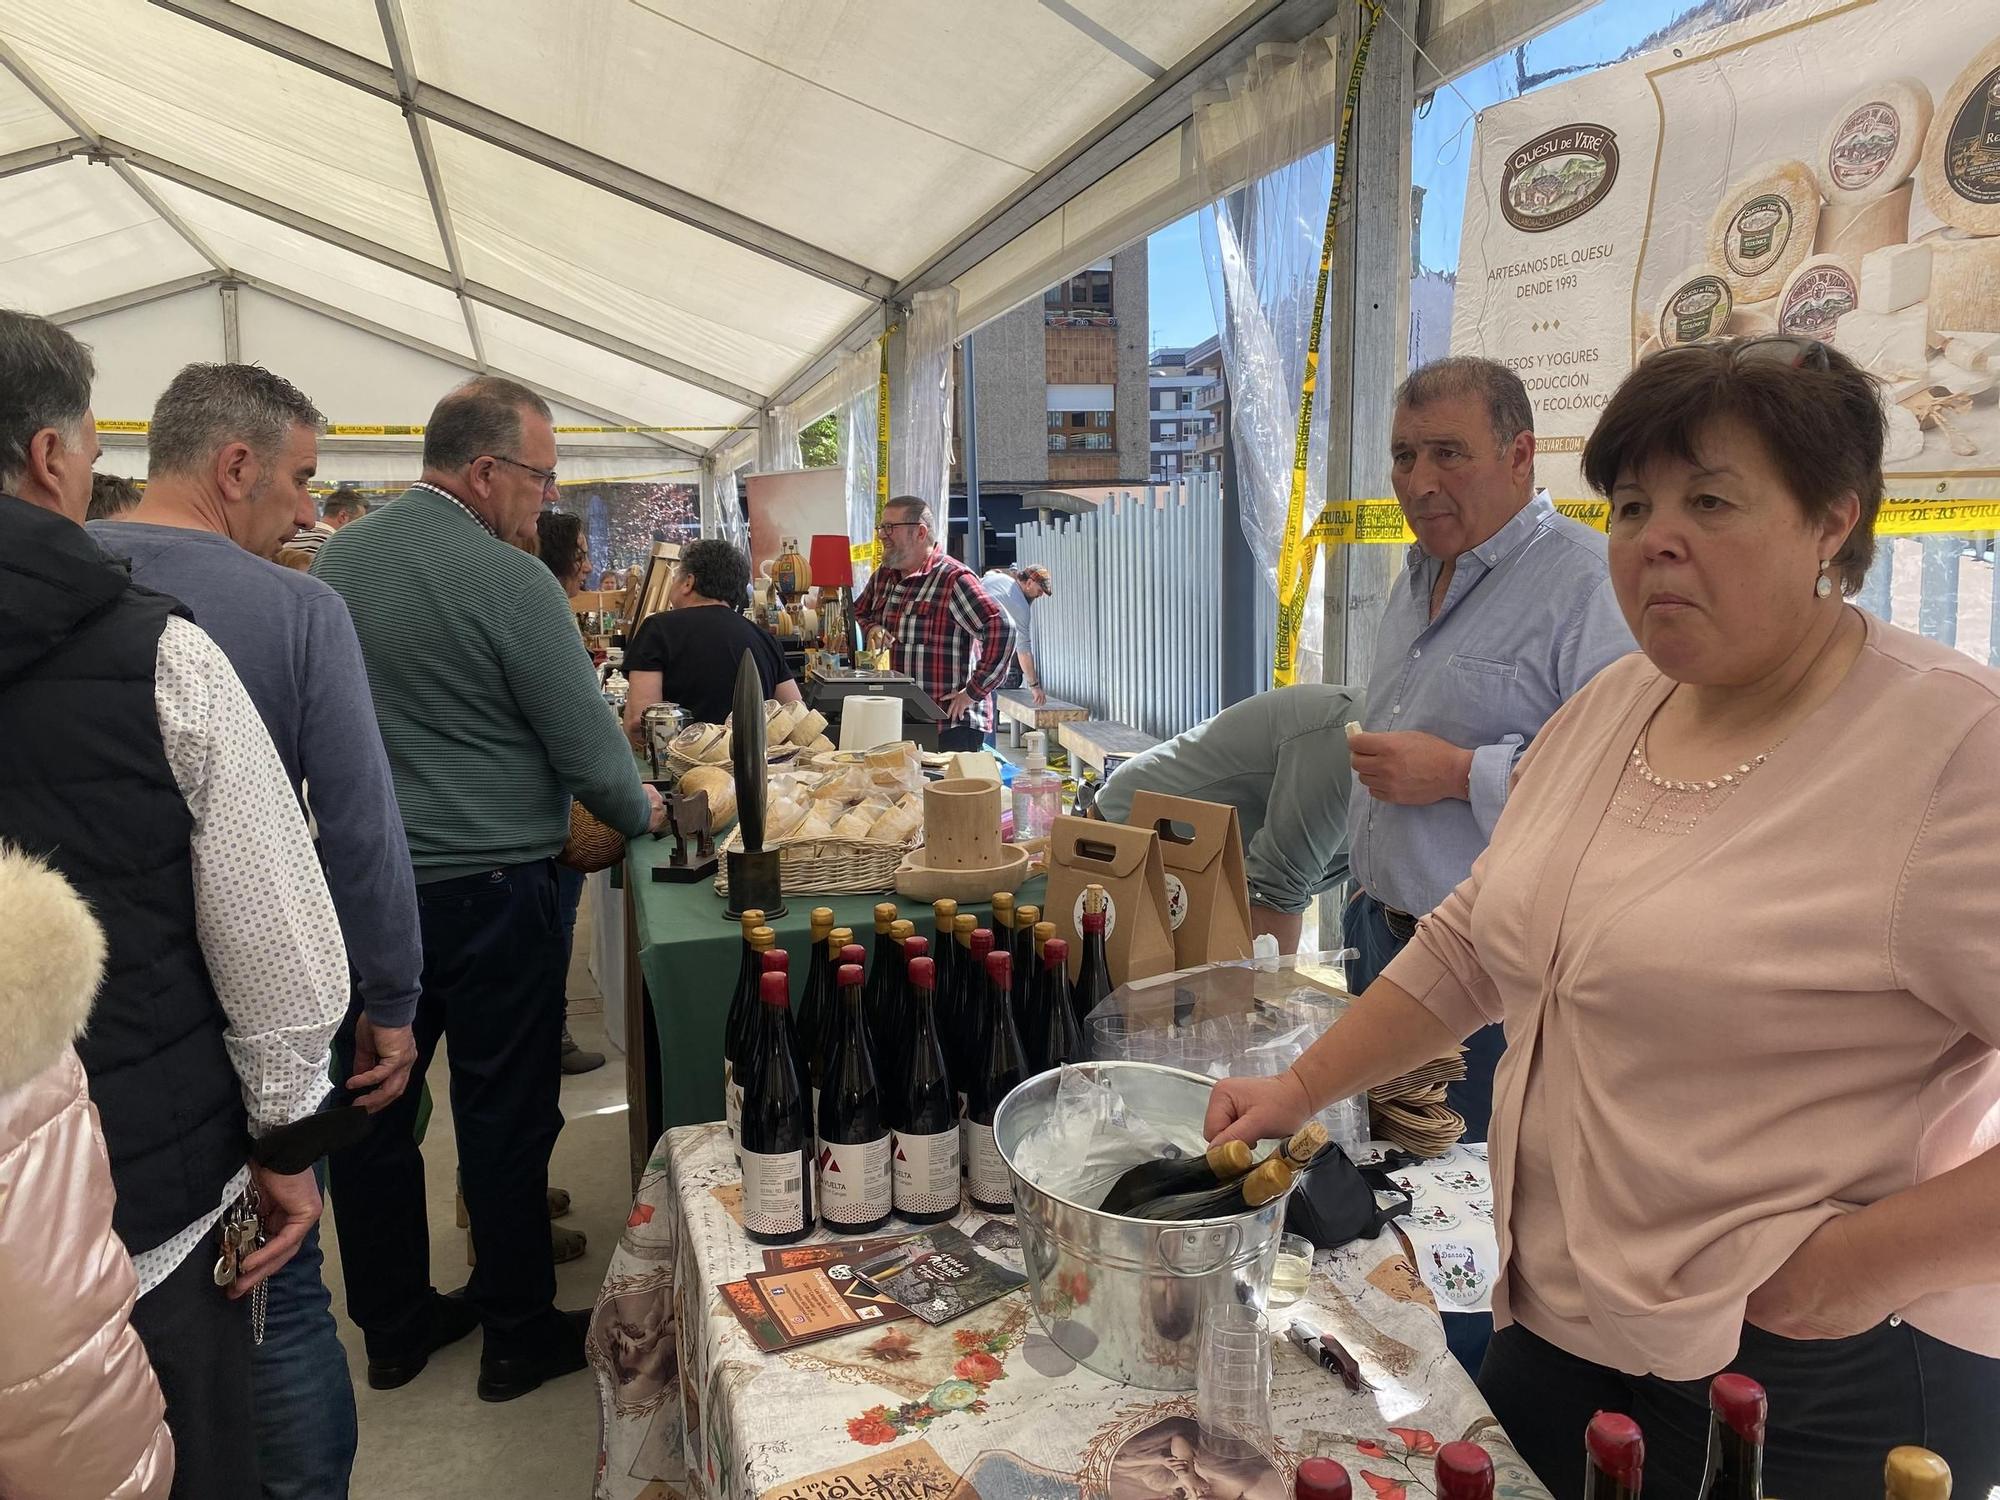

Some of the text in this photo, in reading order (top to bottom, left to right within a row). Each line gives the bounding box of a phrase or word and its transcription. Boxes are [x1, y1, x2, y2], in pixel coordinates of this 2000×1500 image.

[1514, 139, 1558, 169] QUESU
[1488, 243, 1614, 281] ARTESANOS DEL QUESU
[1517, 275, 1578, 298] DENDE 1993
[1500, 348, 1599, 370] UESOS Y YOGURES
[1522, 371, 1589, 391] RODUCCIÓN
[1534, 394, 1609, 411] Y ECOLÓXICA
